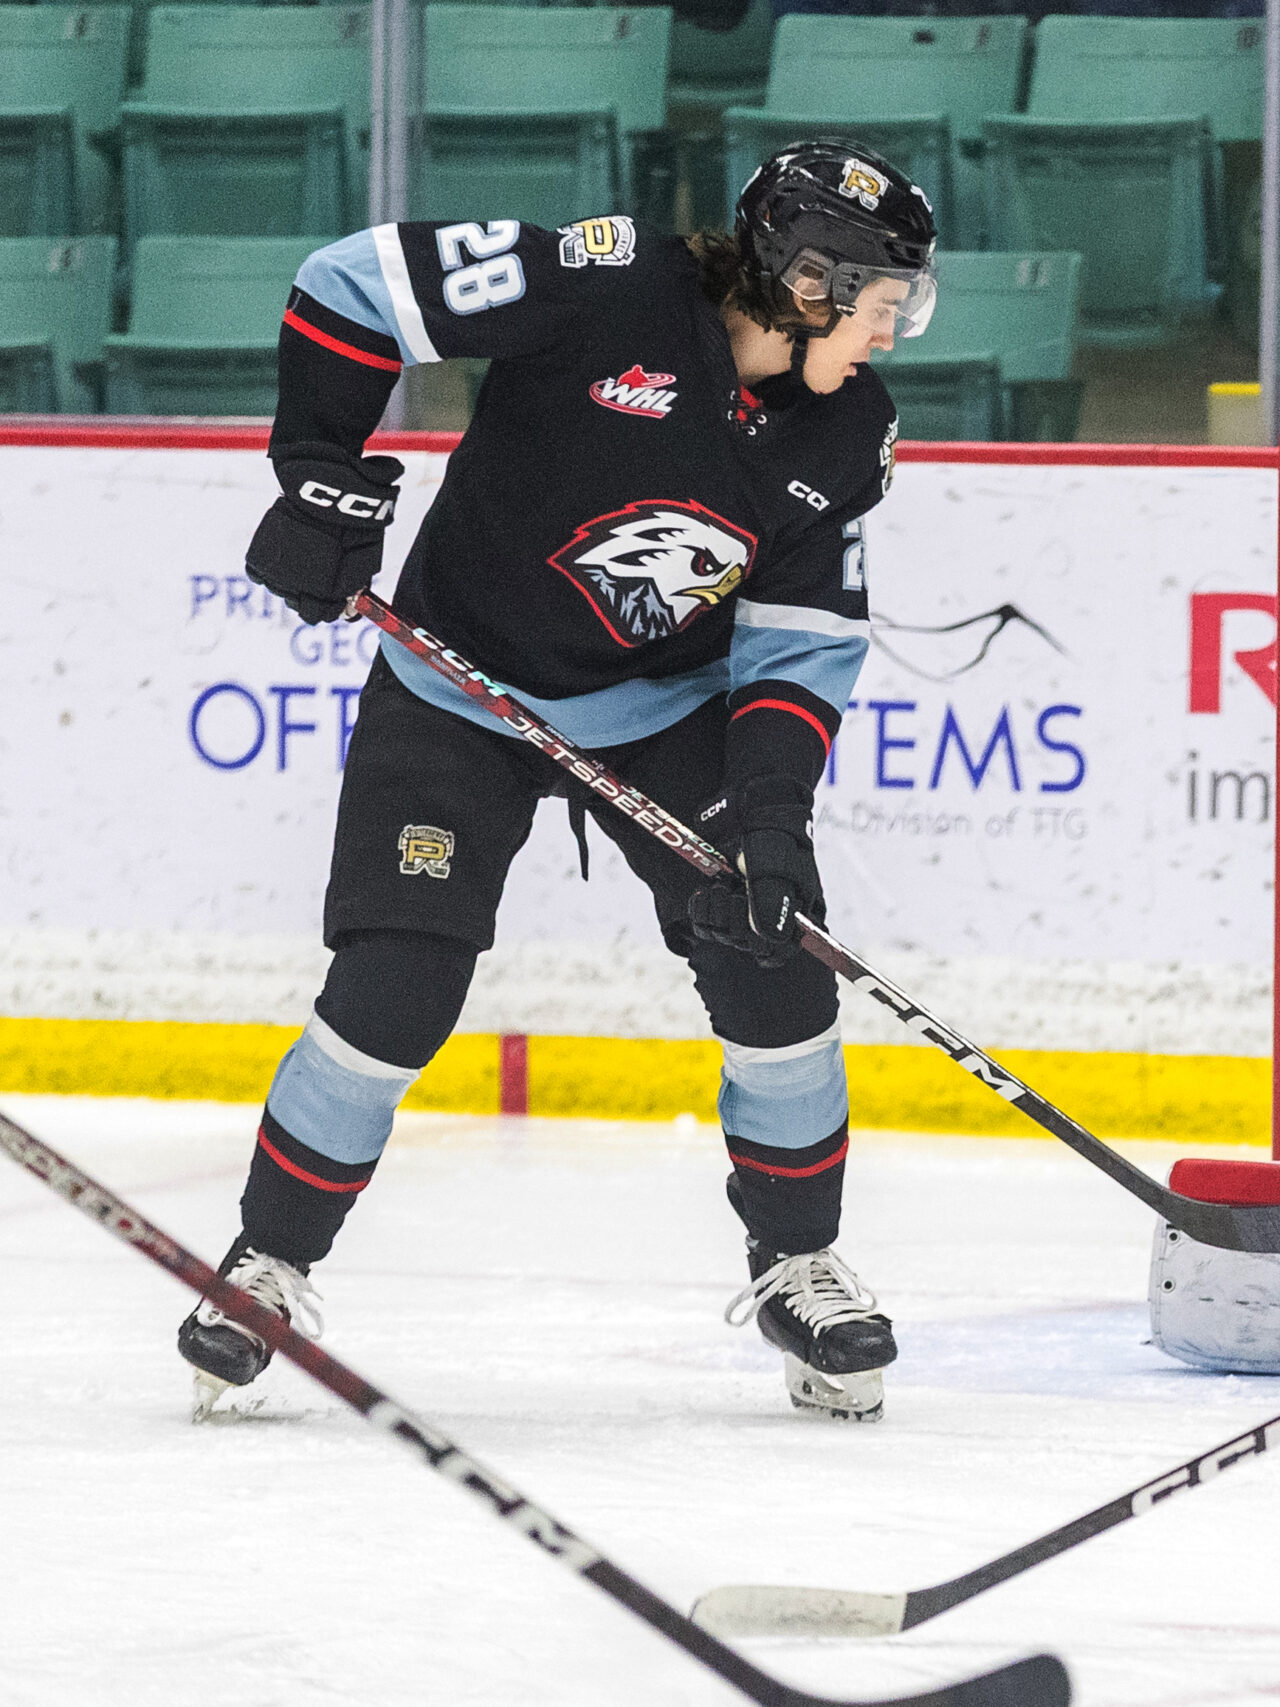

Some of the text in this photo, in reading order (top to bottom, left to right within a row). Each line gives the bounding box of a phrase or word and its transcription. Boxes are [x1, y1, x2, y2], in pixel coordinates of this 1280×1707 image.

[435, 219, 526, 316] 28
[600, 376, 679, 413] WHL
[412, 627, 506, 697] CCM
[503, 716, 684, 848] JETSPEED
[701, 798, 728, 823] CCM
[853, 975, 1027, 1102] CCM
